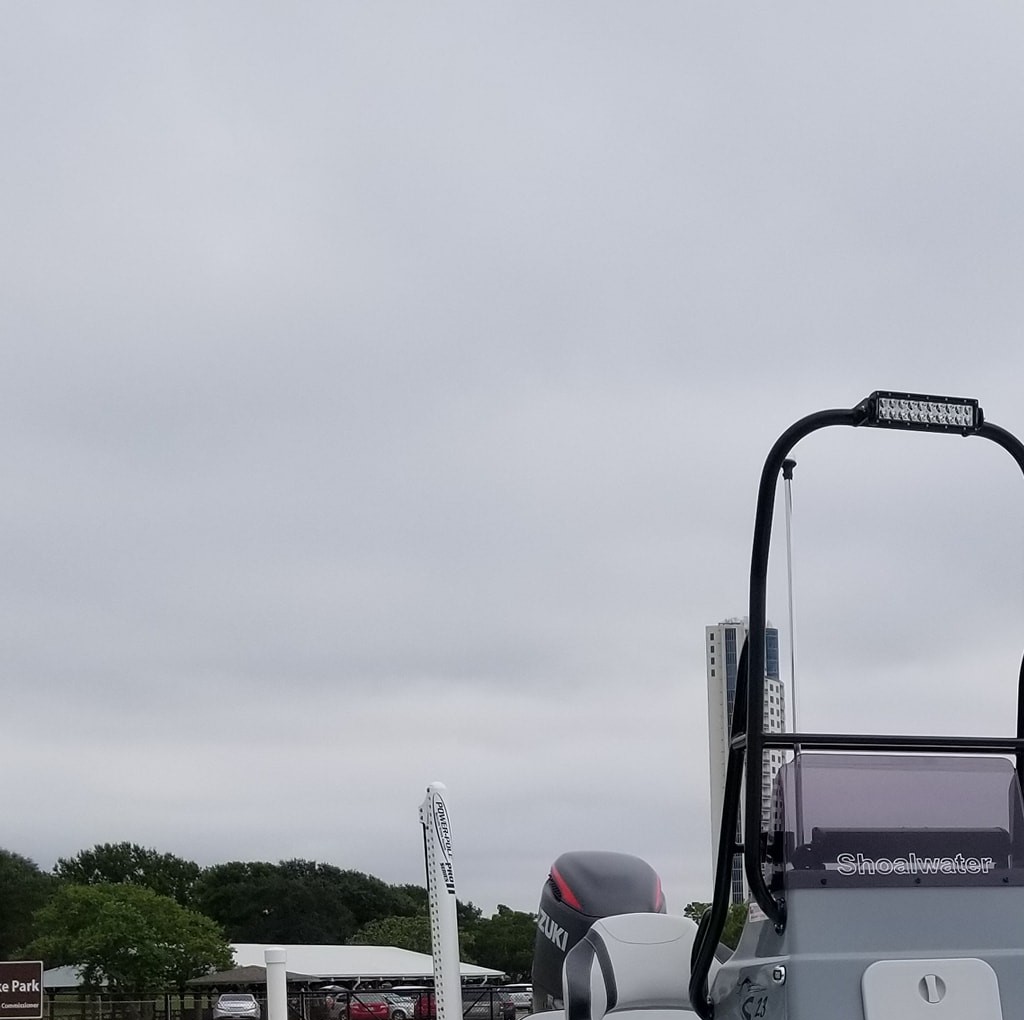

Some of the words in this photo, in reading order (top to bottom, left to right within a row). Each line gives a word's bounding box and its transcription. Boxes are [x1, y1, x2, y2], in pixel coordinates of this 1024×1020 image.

[445, 862, 454, 882] PRO
[836, 852, 993, 875] Shoalwater
[537, 908, 569, 952] ZUKI
[12, 979, 40, 992] Park
